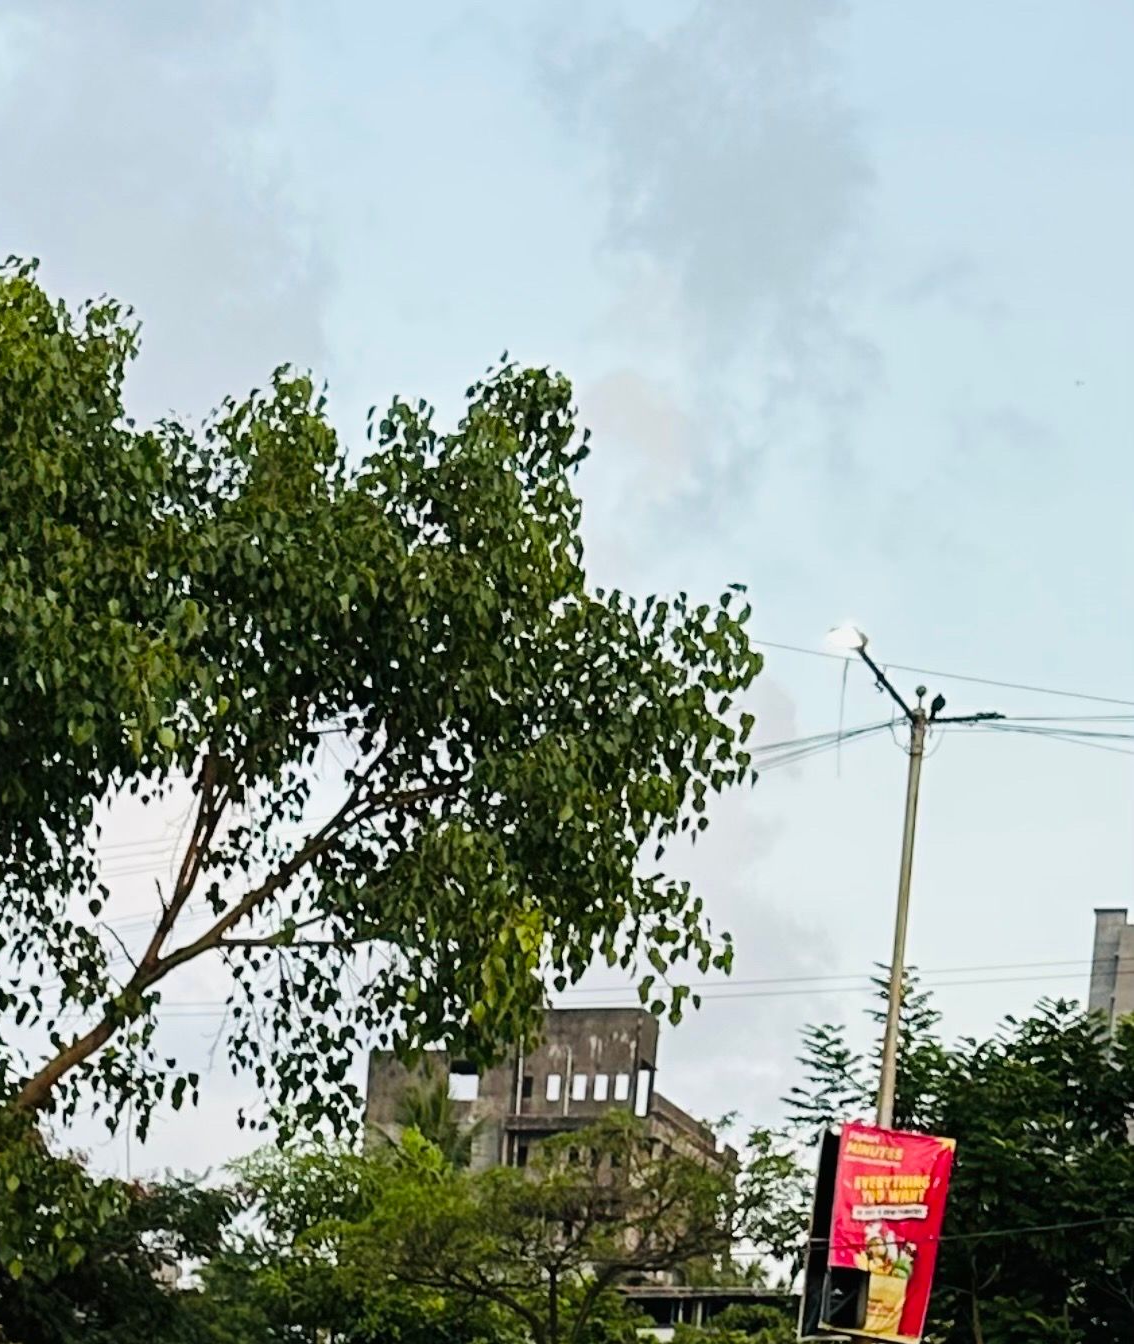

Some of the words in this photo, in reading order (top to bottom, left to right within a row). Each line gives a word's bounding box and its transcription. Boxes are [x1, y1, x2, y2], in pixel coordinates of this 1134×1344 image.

[854, 1175, 931, 1190] EVERYTHING
[861, 1190, 886, 1204] YOU
[888, 1189, 926, 1204] WANT
